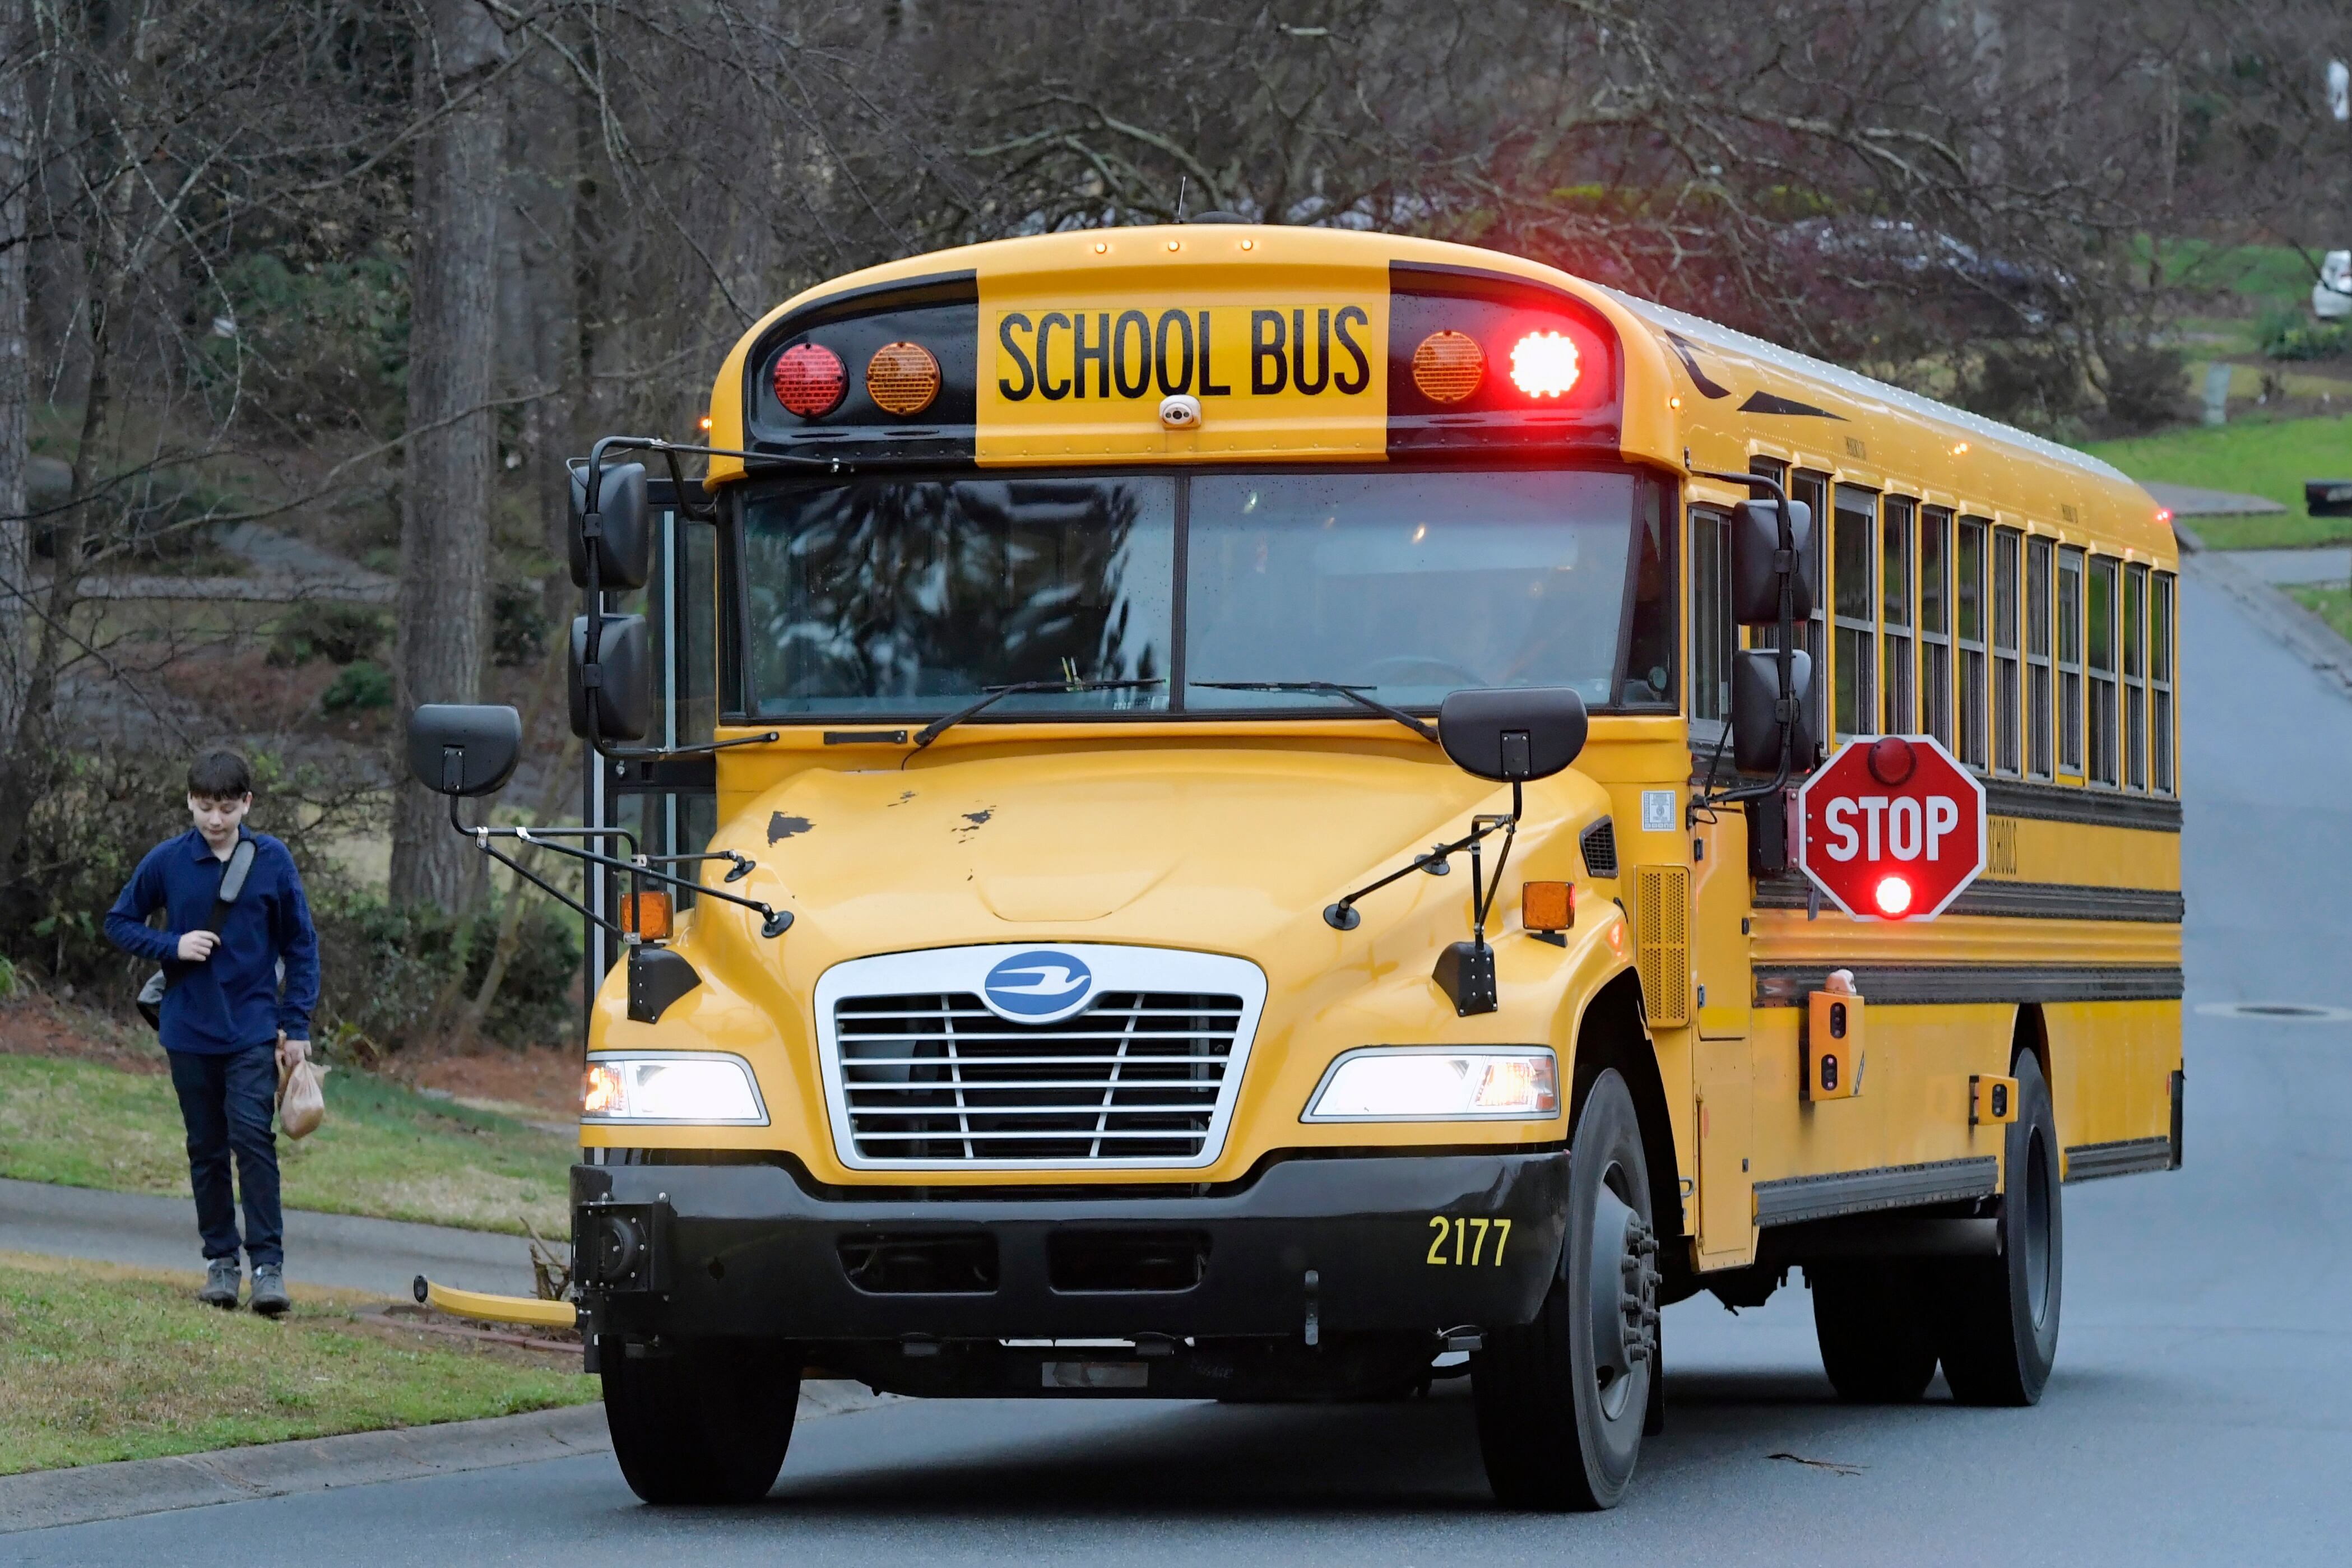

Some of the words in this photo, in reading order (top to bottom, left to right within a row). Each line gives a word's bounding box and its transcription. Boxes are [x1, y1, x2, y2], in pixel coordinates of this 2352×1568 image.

[998, 309, 1231, 402] SCHOOL
[1251, 305, 1371, 396] BUS
[1825, 796, 1959, 861] STOP
[1988, 818, 2017, 875] SCHOOLS
[1427, 1216, 1511, 1267] 2177
